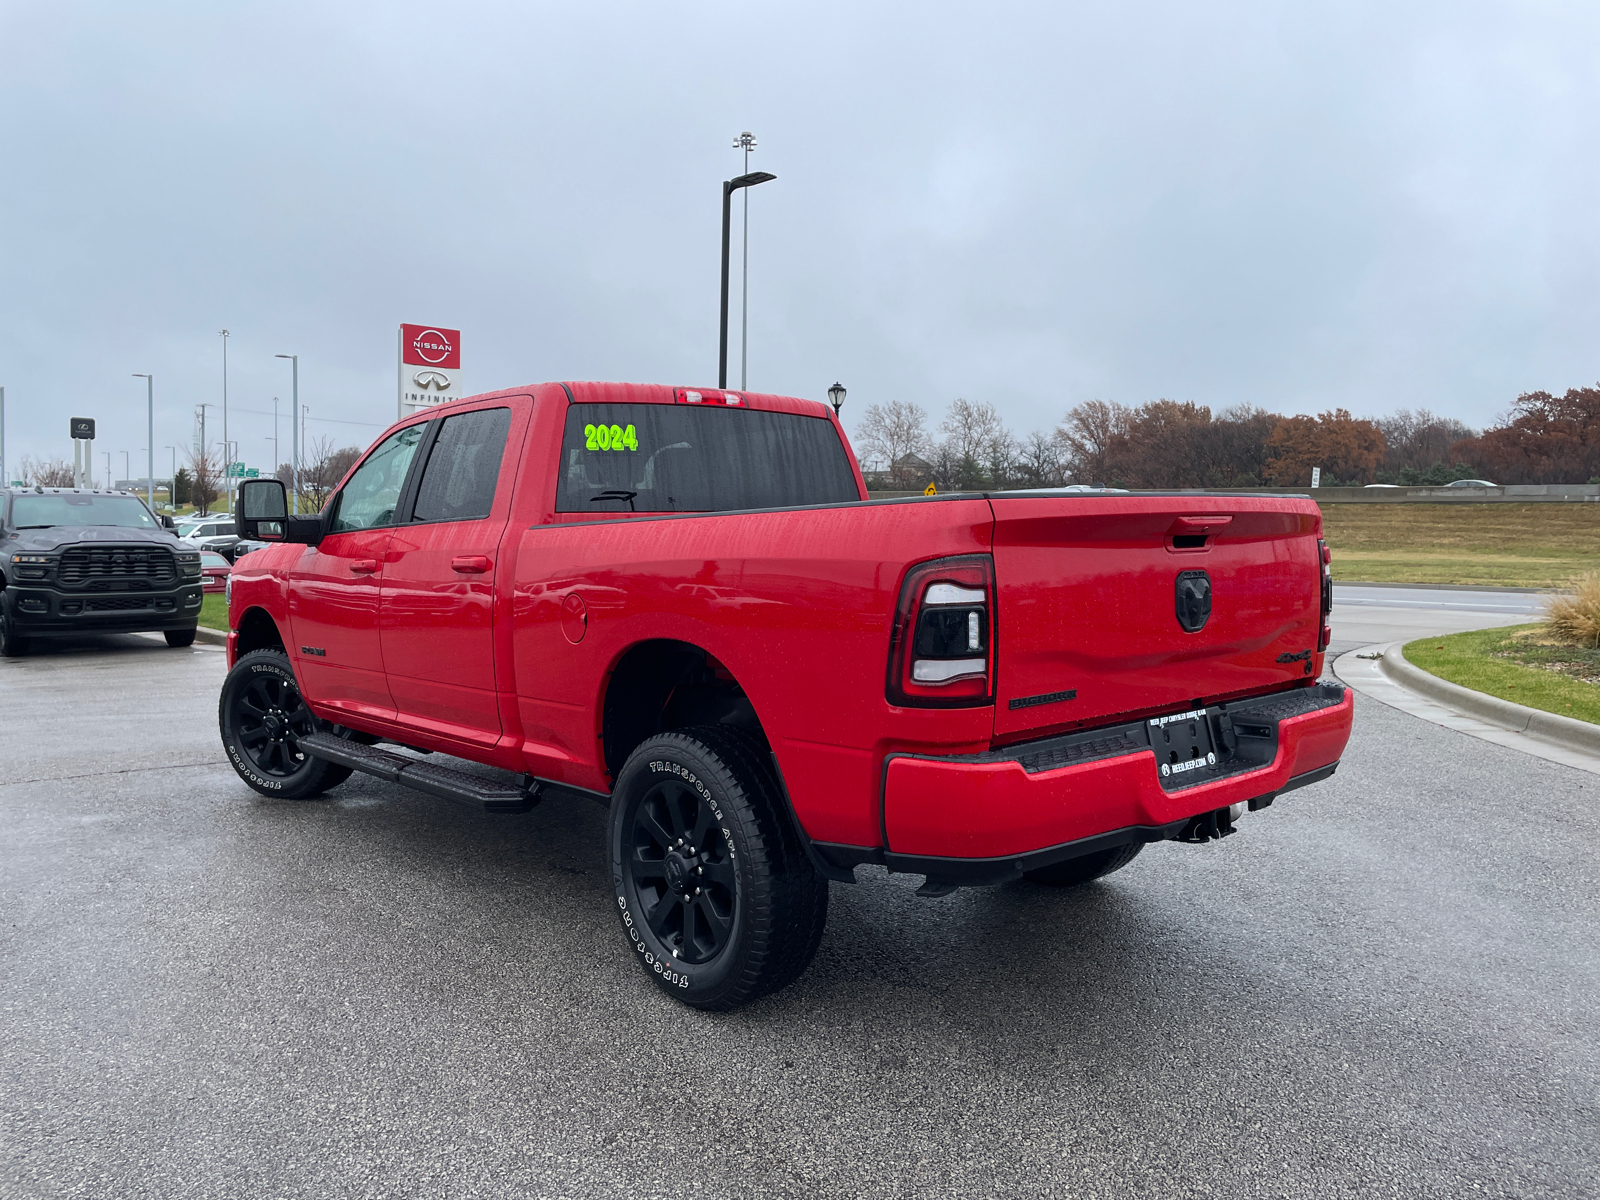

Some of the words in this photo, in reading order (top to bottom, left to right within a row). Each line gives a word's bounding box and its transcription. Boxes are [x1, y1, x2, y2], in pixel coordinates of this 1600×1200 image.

[413, 341, 452, 352] NISSAN
[405, 392, 459, 403] INFINIT
[584, 423, 639, 452] 2024
[301, 645, 326, 657] RAM
[251, 664, 300, 694] TRANSFORC
[649, 760, 723, 822] TRANSFORCE
